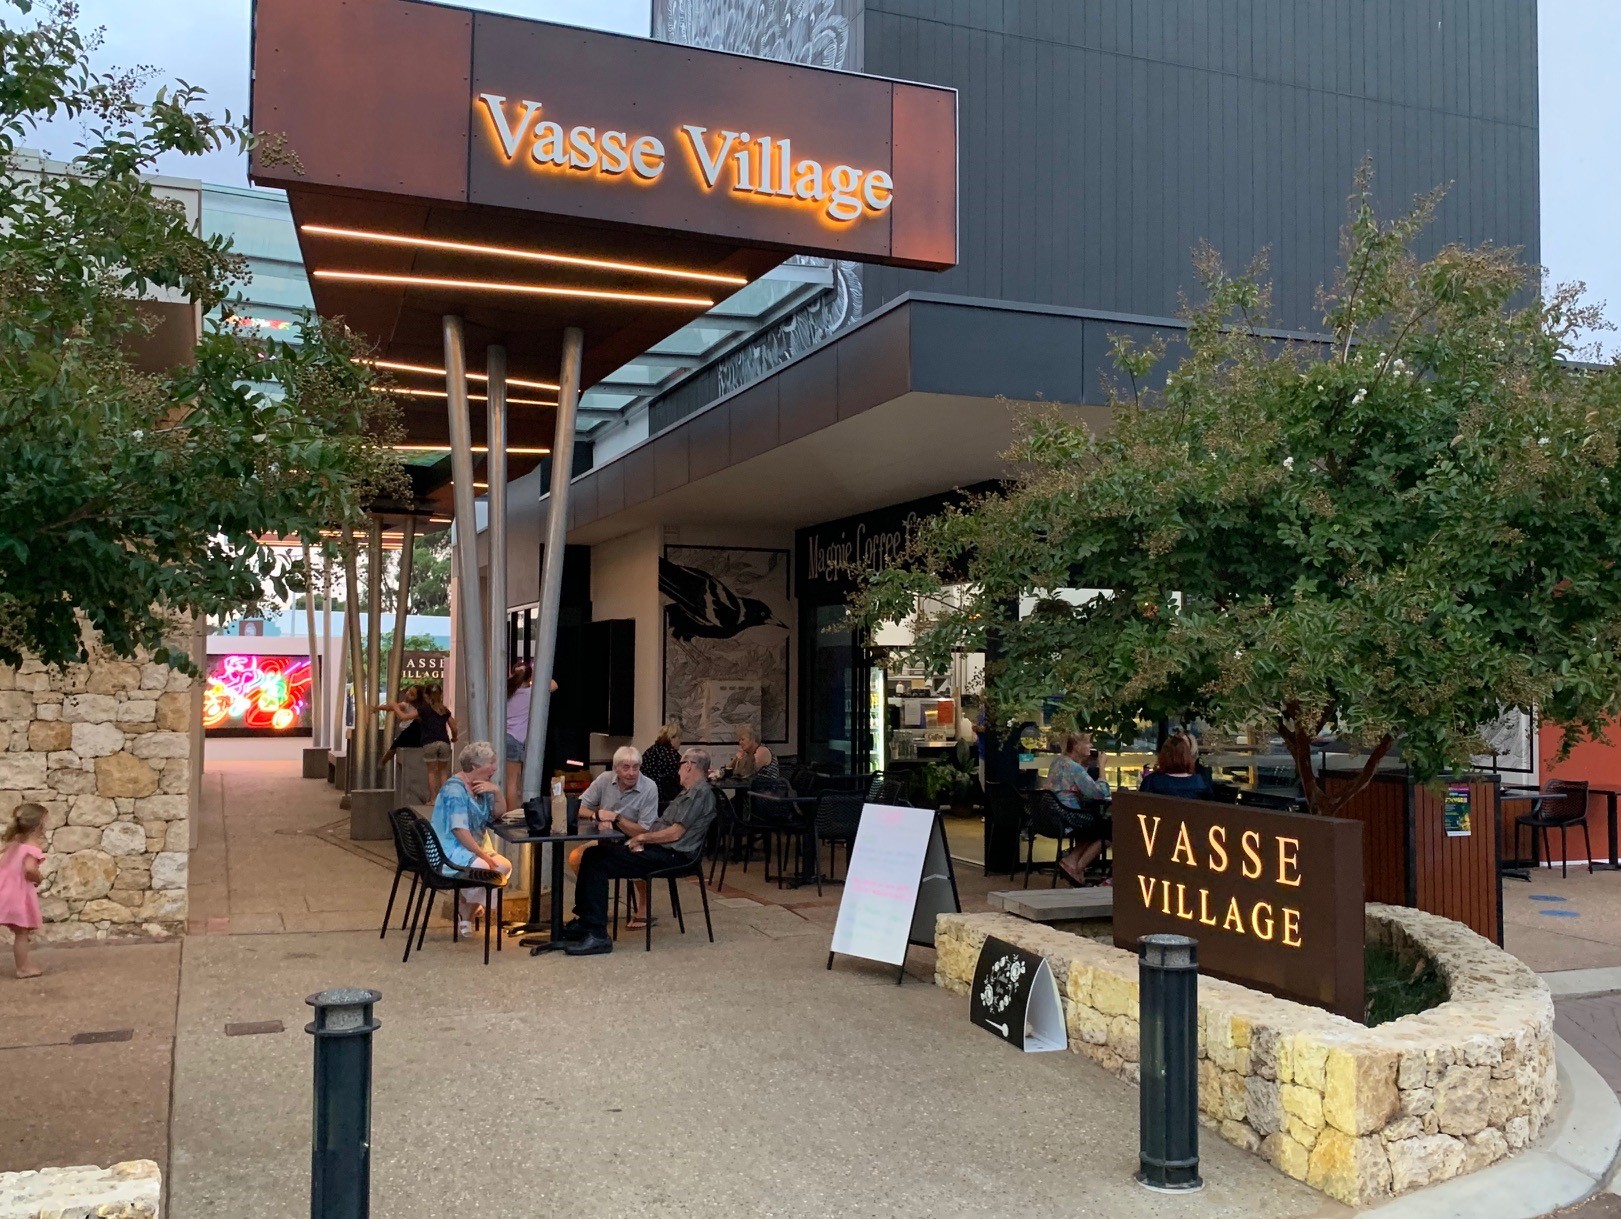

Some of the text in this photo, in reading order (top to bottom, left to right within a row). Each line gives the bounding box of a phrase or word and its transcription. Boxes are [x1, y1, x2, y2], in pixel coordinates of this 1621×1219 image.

[480, 92, 894, 222] Vasse Village
[402, 670, 445, 679] ILLAG
[405, 658, 445, 668] ASS
[1136, 813, 1302, 888] VASSE
[1137, 874, 1303, 947] VILLAGE
